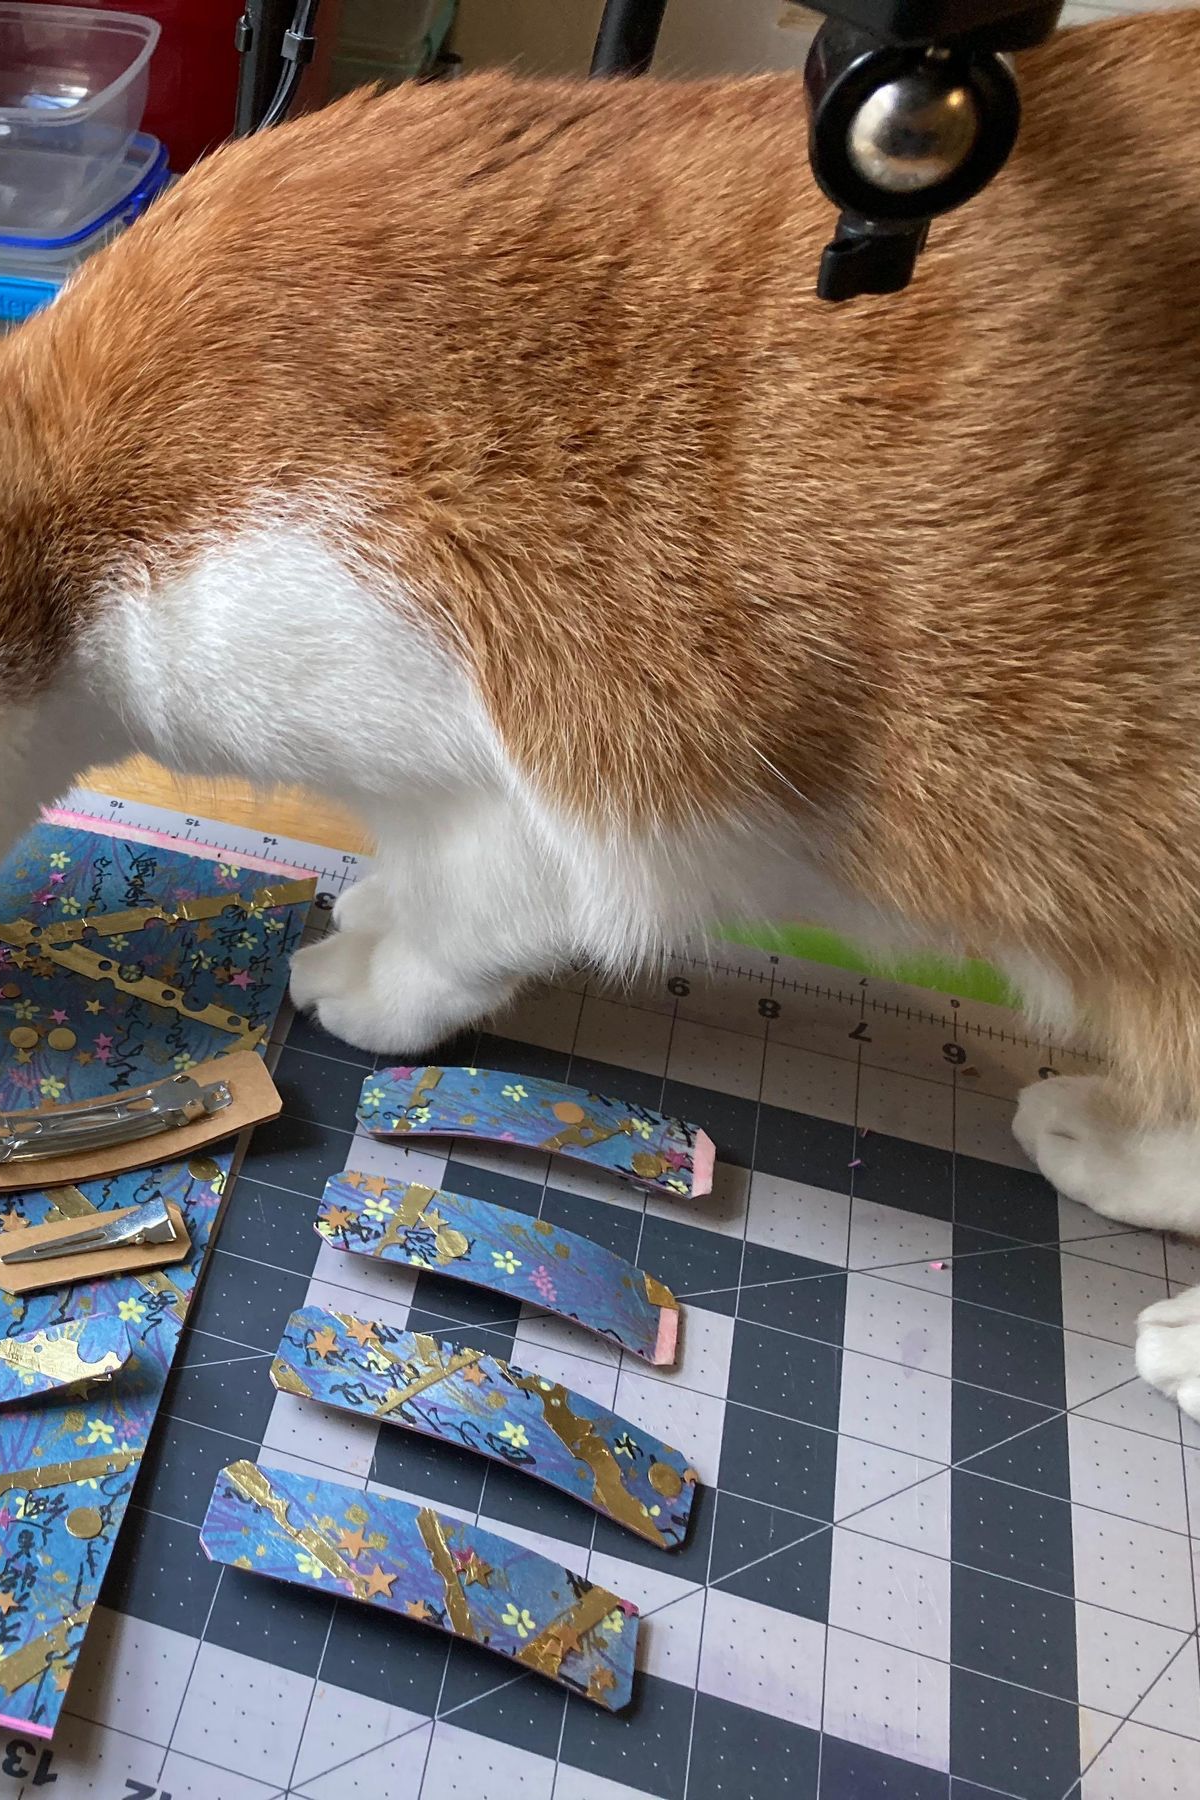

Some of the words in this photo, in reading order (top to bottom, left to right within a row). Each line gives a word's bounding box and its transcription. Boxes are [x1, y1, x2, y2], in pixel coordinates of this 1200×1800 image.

[110, 799, 124, 809] 16
[186, 817, 201, 827] 15
[263, 835, 279, 846] 14
[342, 854, 358, 865] 13
[757, 998, 782, 1020] 8
[848, 1022, 873, 1043] 7
[1, 1738, 59, 1787] 13
